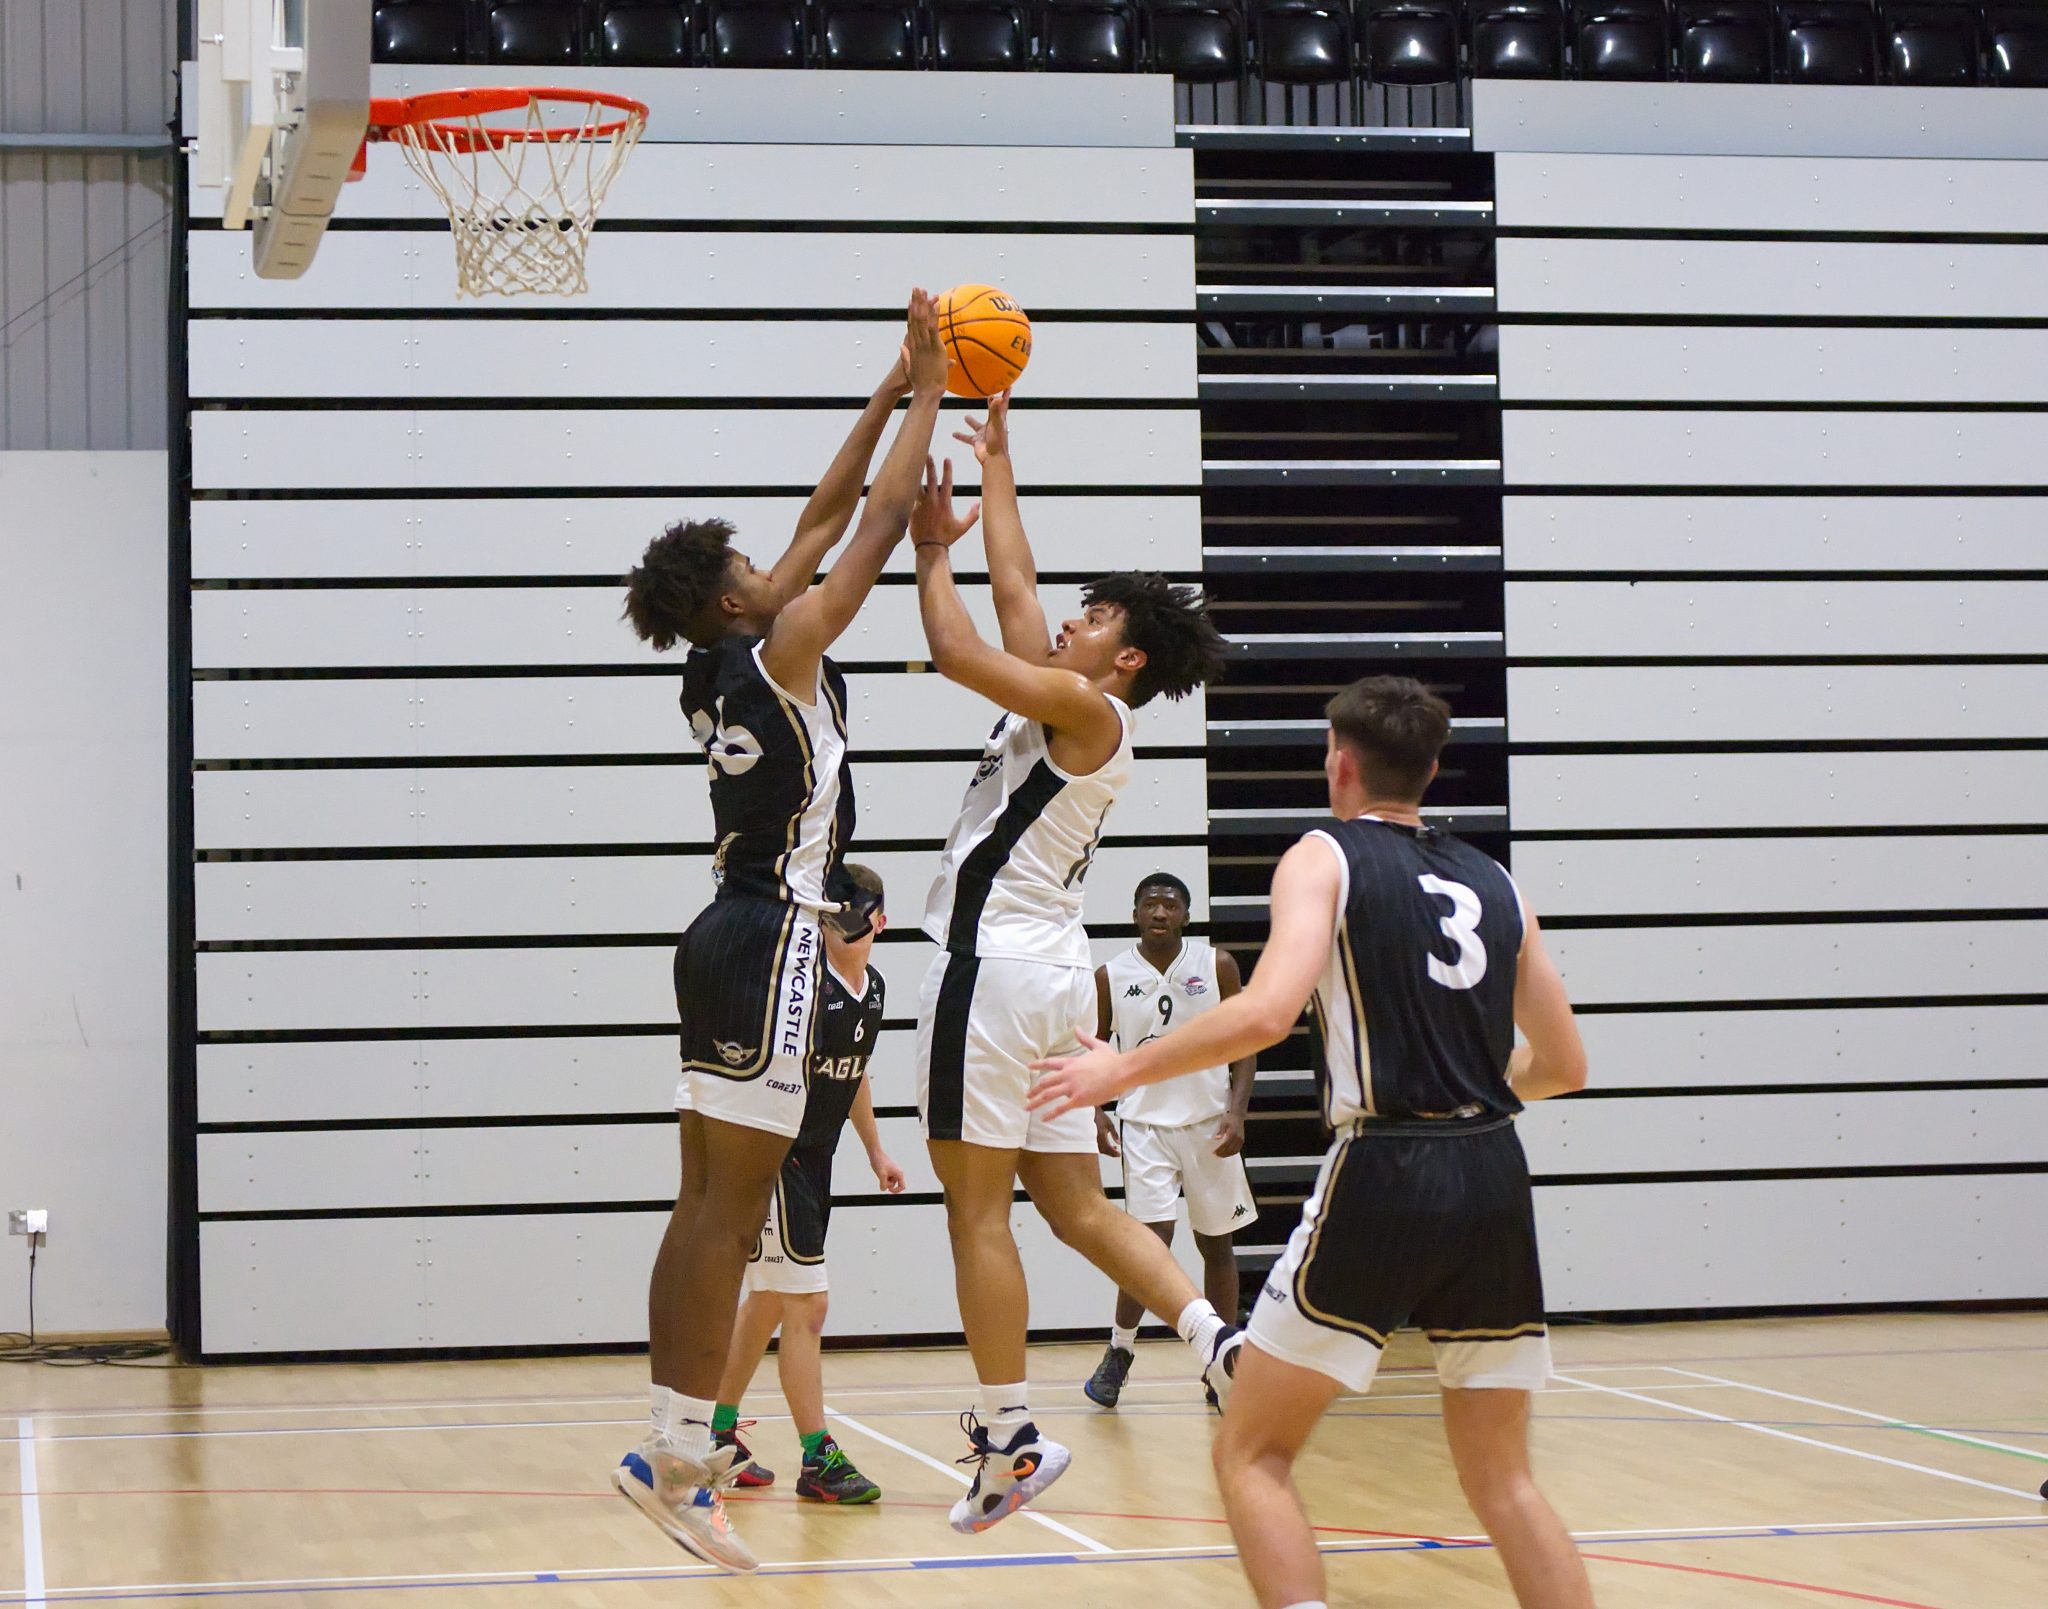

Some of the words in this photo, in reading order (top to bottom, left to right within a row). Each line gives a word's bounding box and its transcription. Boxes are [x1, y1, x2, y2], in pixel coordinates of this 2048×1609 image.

[1418, 873, 1488, 990] 3
[783, 927, 813, 1057] NEWCASTLE
[1158, 995, 1173, 1026] 9
[854, 1018, 865, 1043] 6
[766, 1079, 802, 1095] CORE37
